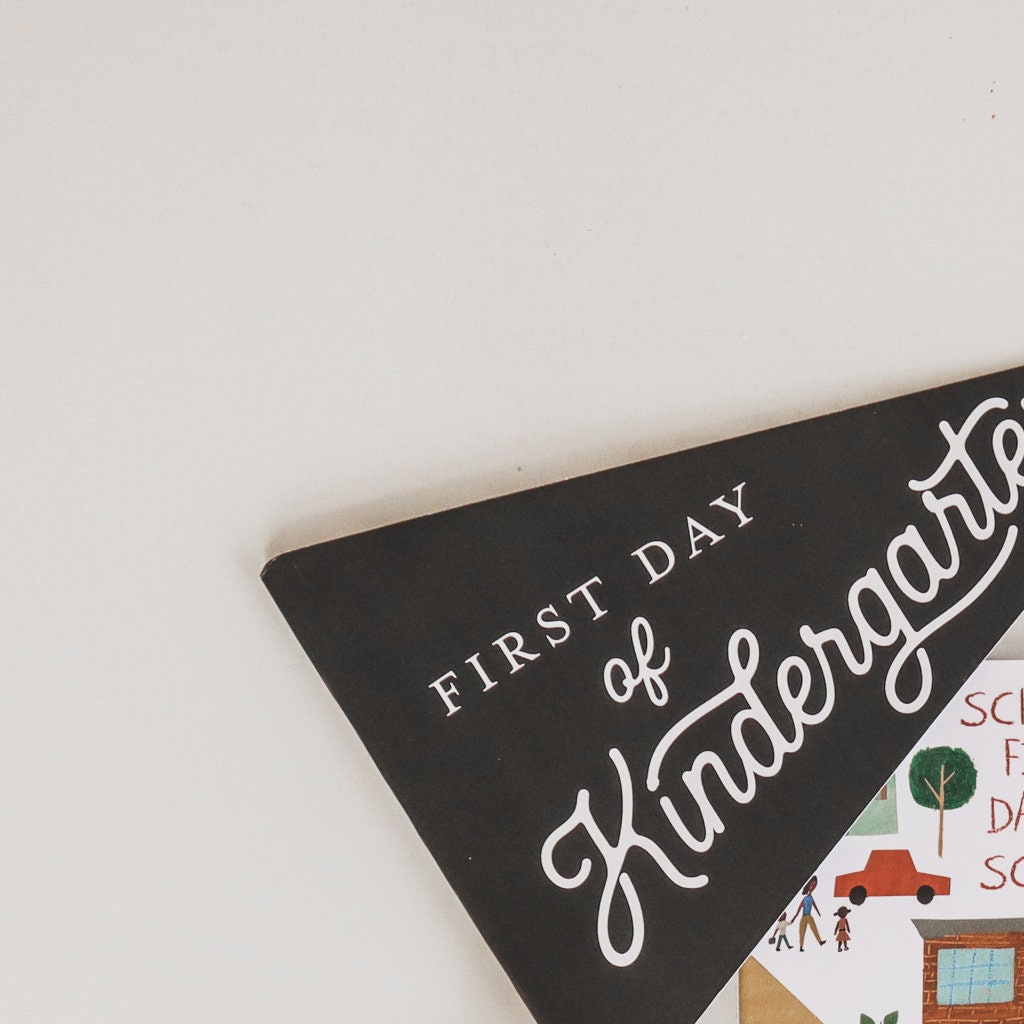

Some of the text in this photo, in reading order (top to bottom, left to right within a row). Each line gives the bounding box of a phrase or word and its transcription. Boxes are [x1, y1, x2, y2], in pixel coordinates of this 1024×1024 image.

[428, 482, 753, 717] FIRST DAY
[603, 616, 671, 707] of
